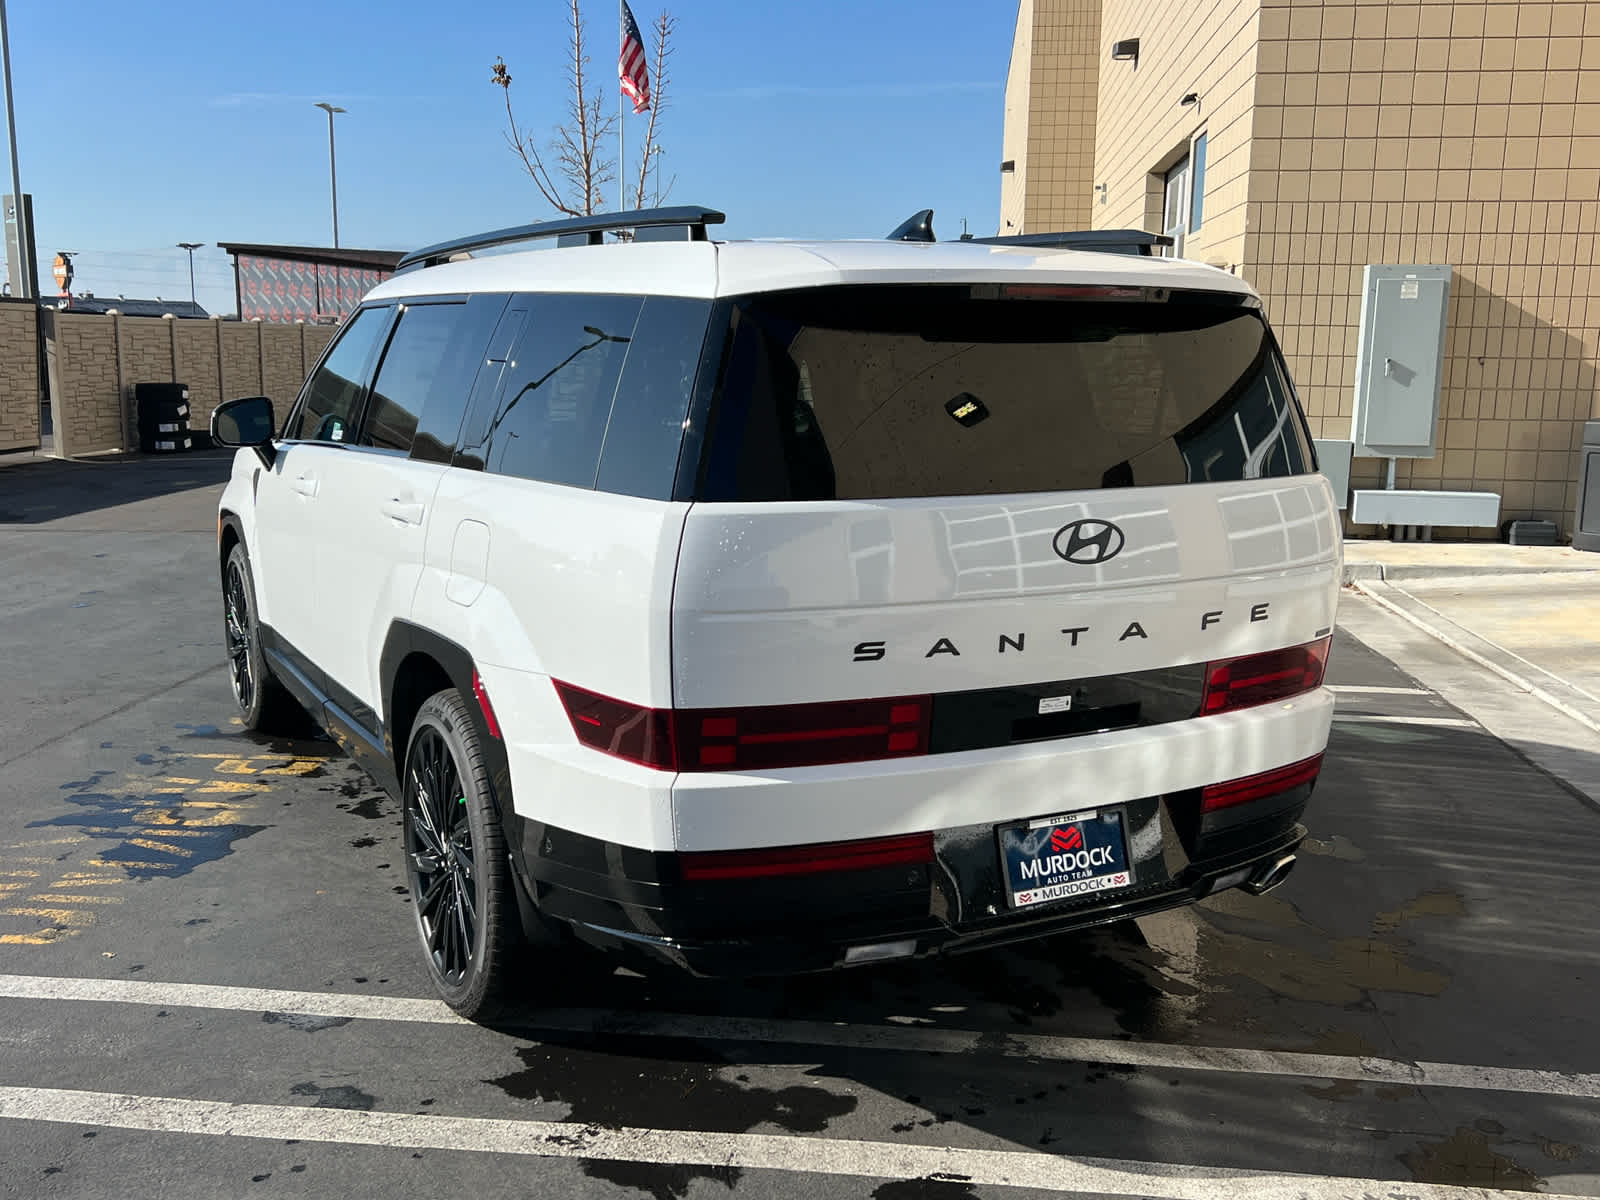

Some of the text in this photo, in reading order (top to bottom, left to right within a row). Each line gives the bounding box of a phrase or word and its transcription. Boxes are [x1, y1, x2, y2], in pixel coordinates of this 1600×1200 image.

[853, 603, 1269, 662] SANTA FE
[1020, 845, 1114, 880] MURDOCK
[1042, 879, 1105, 899] MURDOCK
[1047, 869, 1093, 885] AUTO TEAM
